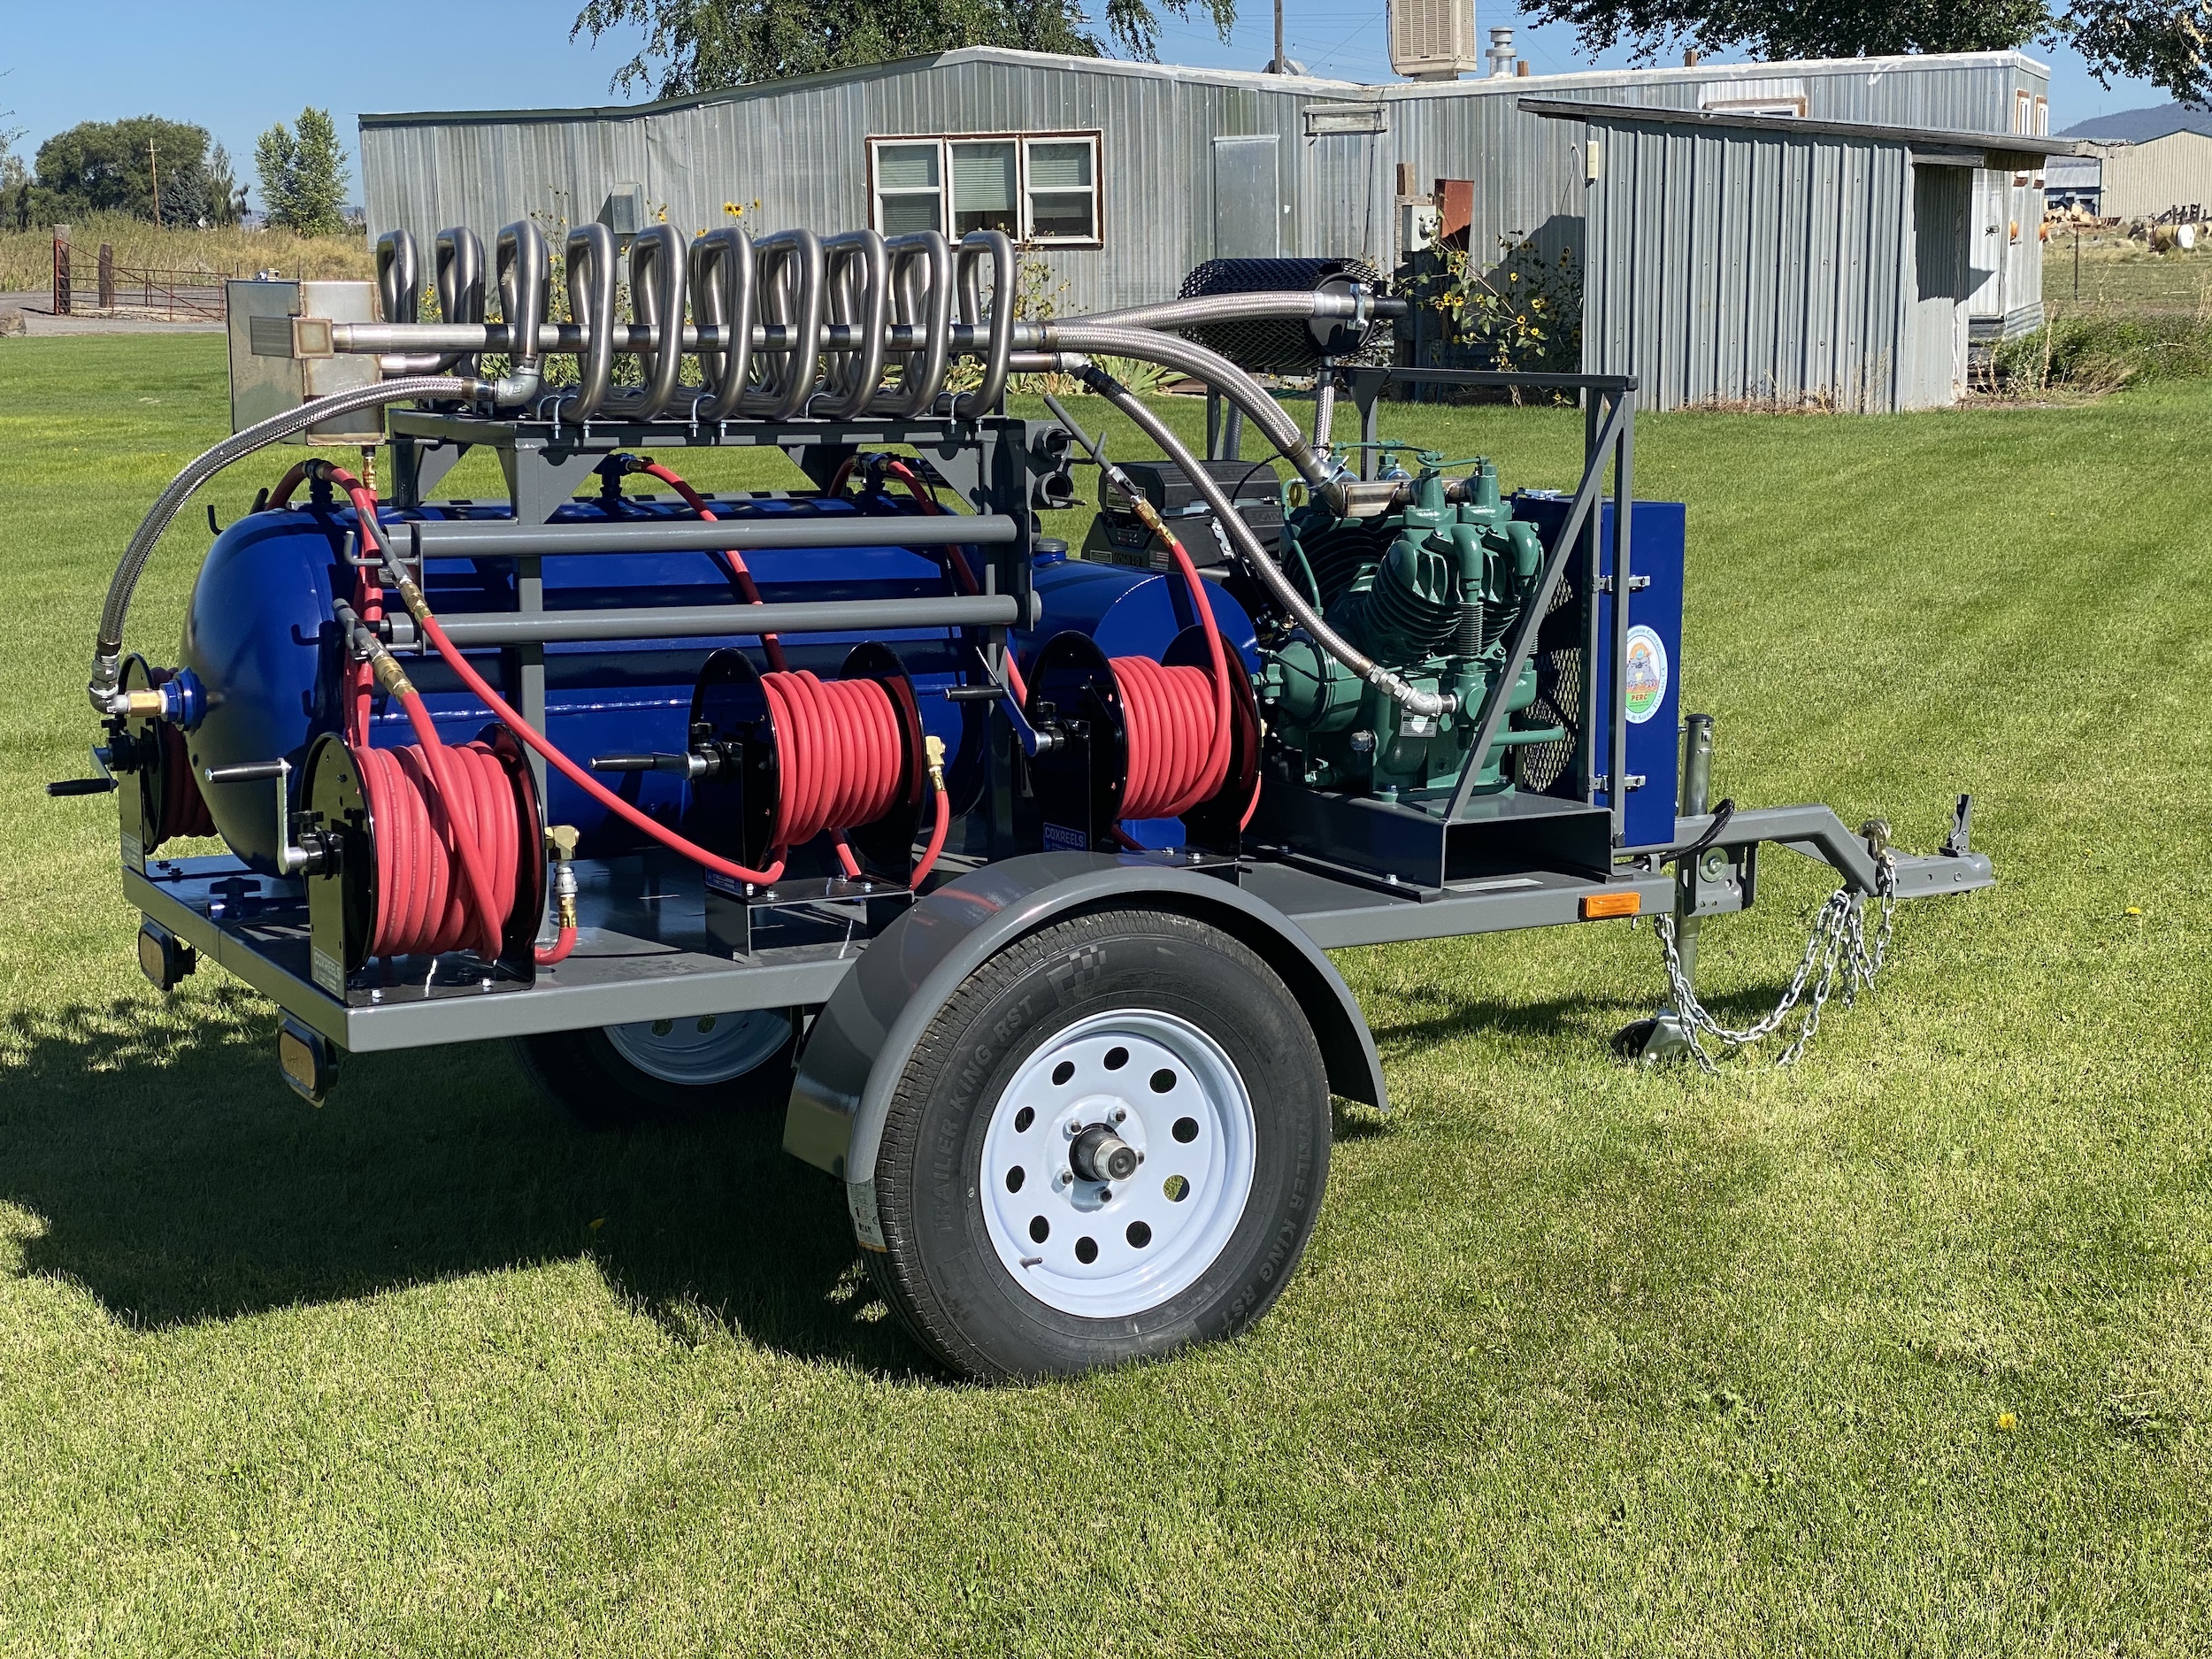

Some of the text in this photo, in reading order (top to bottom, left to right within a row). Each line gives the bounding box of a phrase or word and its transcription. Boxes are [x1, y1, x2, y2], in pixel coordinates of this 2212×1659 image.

[1112, 552, 1141, 567] KOHLER
[1045, 826, 1084, 848] COXREELS
[314, 951, 341, 980] COXREELS
[932, 994, 1033, 1231] TRAILER KING RST
[1258, 1217, 1298, 1282] KING
[1221, 1285, 1258, 1330] RST
